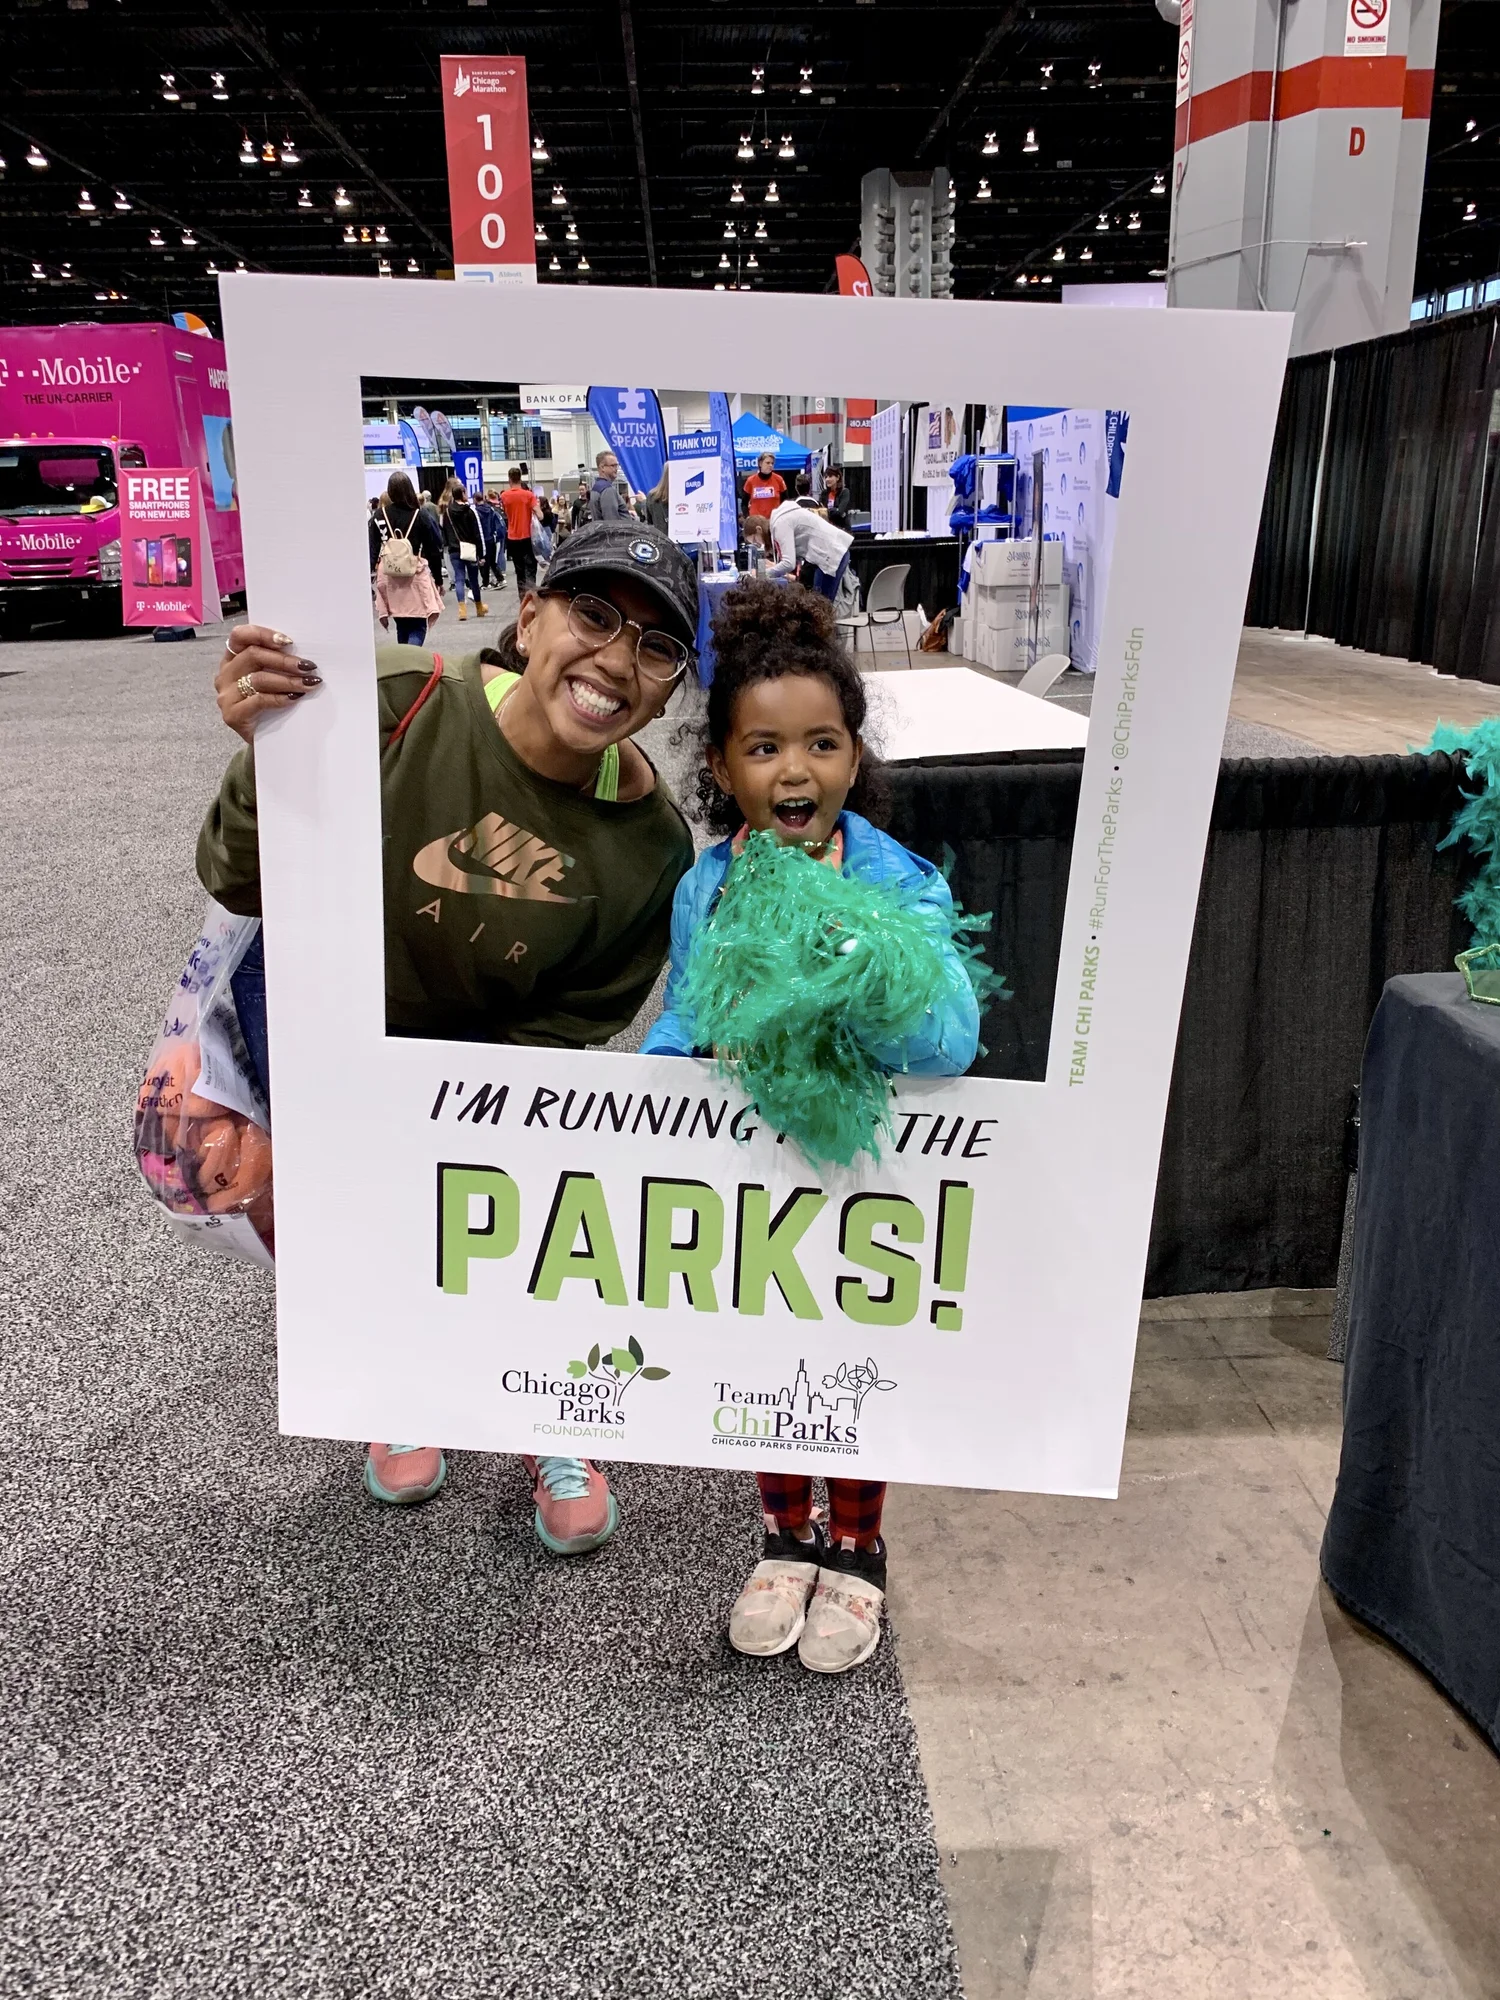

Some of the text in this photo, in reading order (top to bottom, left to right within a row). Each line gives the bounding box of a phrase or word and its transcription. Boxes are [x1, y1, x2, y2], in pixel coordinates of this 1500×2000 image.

[1357, 35, 1386, 43] SMOKING
[472, 77, 500, 87] Chicago
[472, 85, 507, 93] Marathon
[1349, 127, 1366, 156] D
[24, 392, 113, 404] THE UN-CARRIER
[526, 395, 555, 404] BANK
[558, 395, 572, 403] OF
[609, 422, 658, 435] AUTISM
[612, 435, 656, 448] SPEAKS
[671, 438, 700, 450] THANK
[700, 436, 718, 448] YOU
[127, 477, 190, 500] FREE
[685, 480, 702, 488] BAIRD
[128, 500, 190, 510] SMARTPHONES
[129, 510, 191, 519] FOR NEW LINES
[1069, 627, 1145, 1087] TEAM CHI PARKS #RunForTheParks @ChiParksFdn
[415, 897, 528, 964] AIR
[430, 1080, 509, 1125] I'M
[523, 1087, 760, 1142] RUNNING
[895, 1112, 999, 1158] THE
[436, 1161, 976, 1332] PARKS!
[502, 1369, 611, 1406] Chicago
[713, 1382, 780, 1406] Team
[557, 1399, 626, 1426] Parks
[533, 1423, 625, 1440] FOUNDATION
[712, 1405, 858, 1444] ChiParks
[711, 1437, 859, 1456] CHICAGO PARKS FOUNDATION
